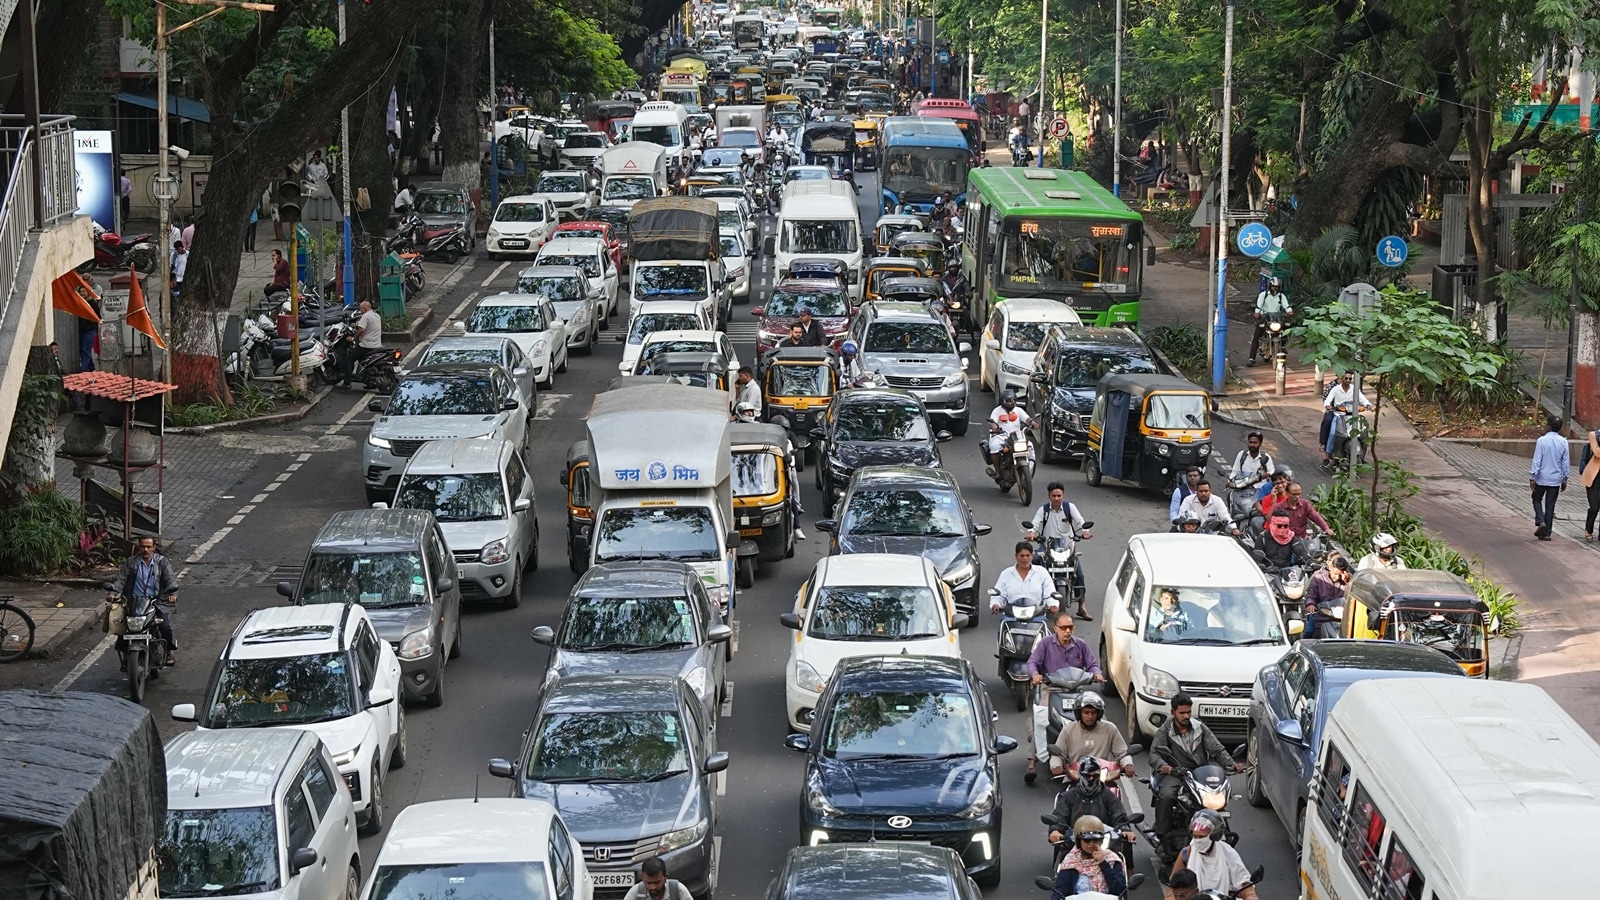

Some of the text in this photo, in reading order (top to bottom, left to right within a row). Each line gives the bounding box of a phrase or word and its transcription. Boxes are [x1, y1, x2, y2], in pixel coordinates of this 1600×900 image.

[1010, 275, 1038, 283] PMPML
[615, 469, 640, 481] जय
[592, 874, 633, 885] 2GF6875
